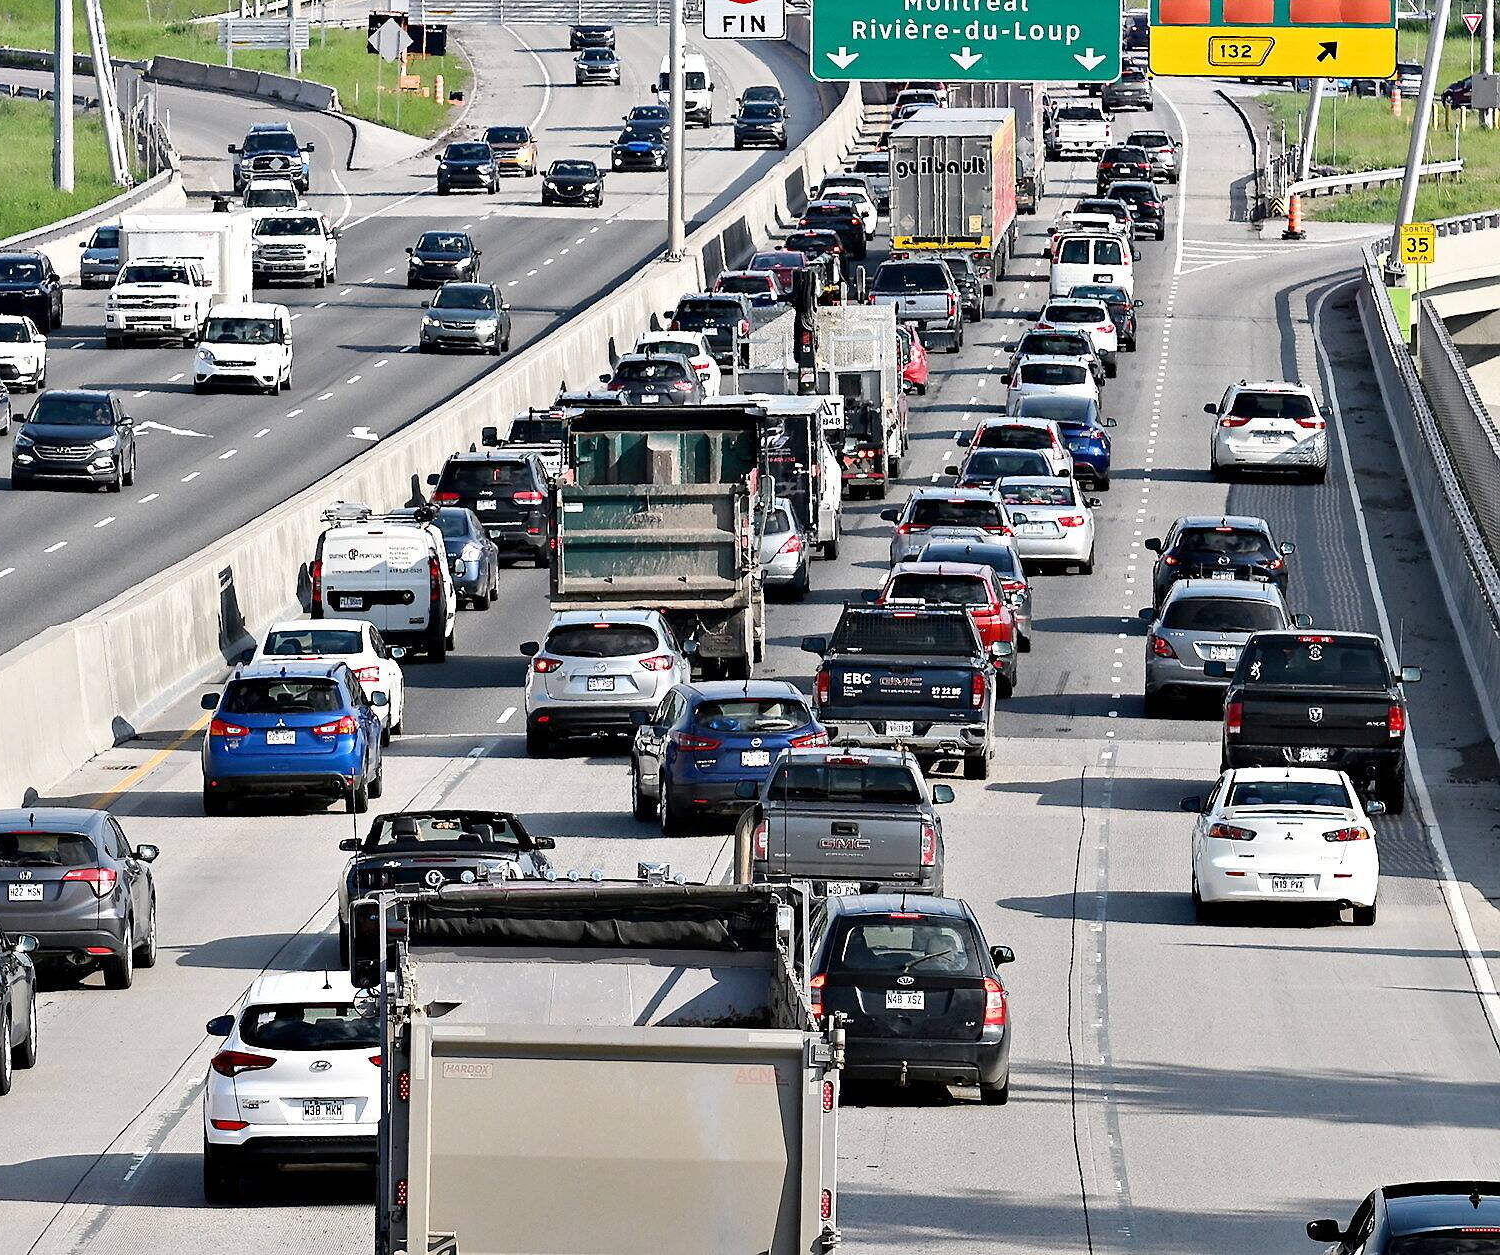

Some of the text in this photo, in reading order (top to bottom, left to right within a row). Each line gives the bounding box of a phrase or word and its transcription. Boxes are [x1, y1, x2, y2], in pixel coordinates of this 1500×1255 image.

[722, 15, 766, 33] FIN
[852, 19, 1081, 46] Rivière-du-Loup
[1220, 44, 1252, 59] 132
[895, 155, 987, 179] guilbault
[1406, 237, 1429, 253] 35
[843, 672, 872, 685] EBC
[819, 837, 871, 849] GMC
[445, 1064, 489, 1073] HARDOX
